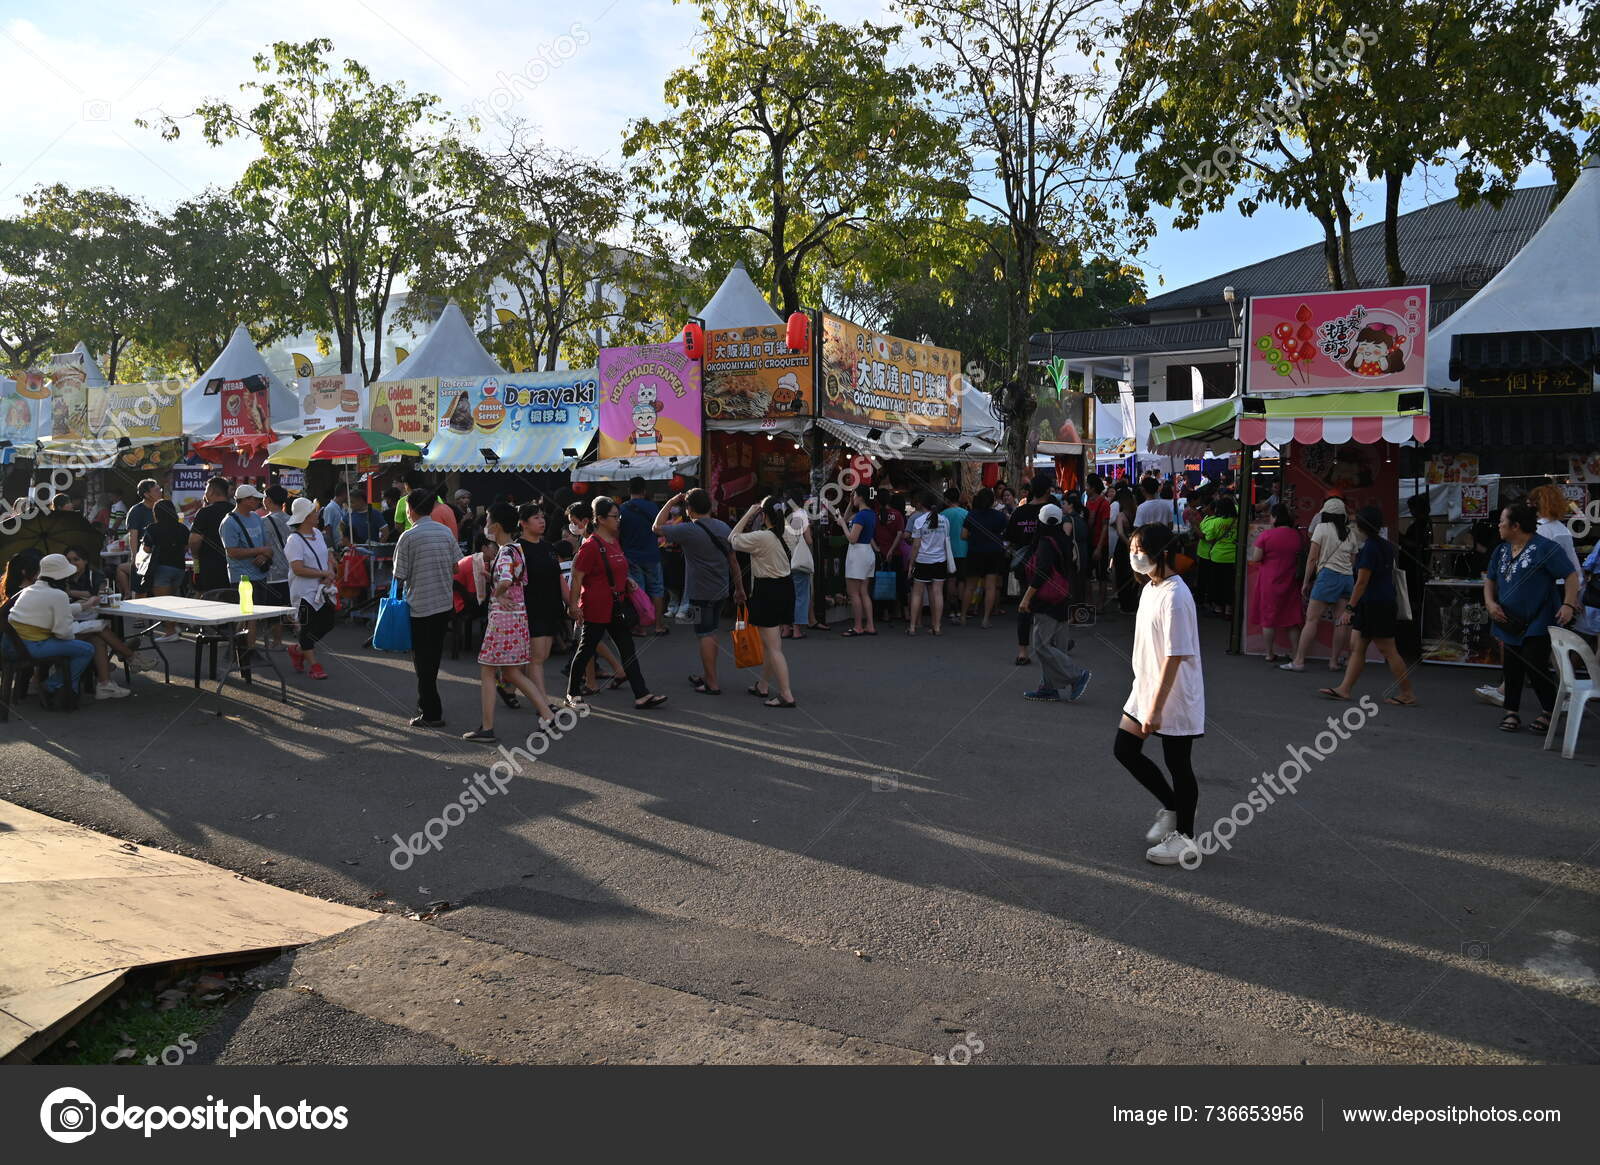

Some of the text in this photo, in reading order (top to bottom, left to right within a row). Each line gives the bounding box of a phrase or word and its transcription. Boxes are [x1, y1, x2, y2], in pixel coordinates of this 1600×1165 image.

[706, 361, 757, 372] OKONOMIYAKI
[764, 357, 809, 369] CROQUETTE
[223, 382, 244, 391] KEBAB
[610, 362, 656, 404] HOMEMADE
[656, 364, 687, 399] RAMEN
[389, 385, 413, 400] Golden
[504, 381, 595, 408] Dorayaki
[395, 401, 418, 416] Cheese
[854, 390, 906, 413] OKONOMIYAKI
[223, 418, 239, 427] NASI
[398, 419, 421, 432] Potato
[223, 426, 245, 435] LEMAK
[180, 471, 202, 479] NASI
